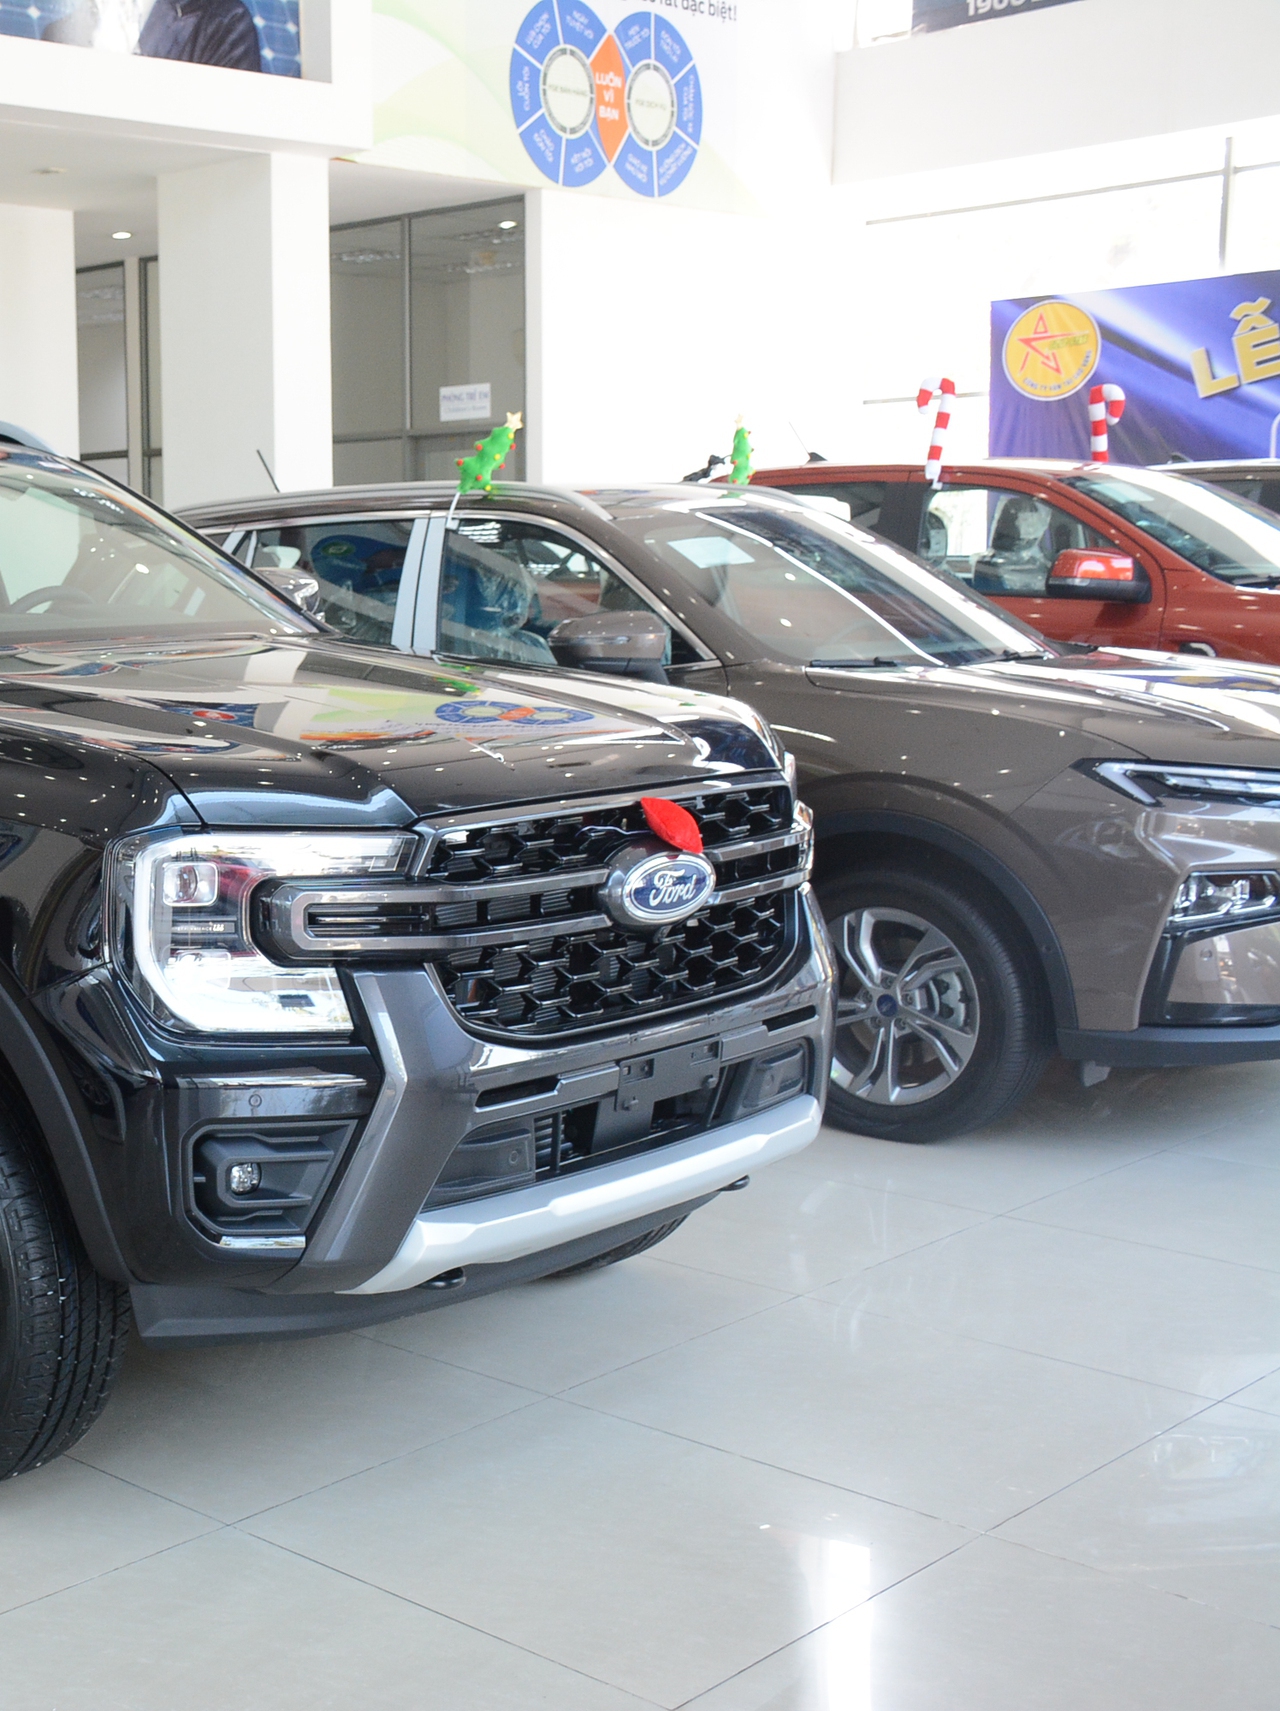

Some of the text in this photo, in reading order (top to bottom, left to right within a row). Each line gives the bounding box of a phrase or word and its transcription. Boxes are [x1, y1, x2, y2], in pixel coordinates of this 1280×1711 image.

[595, 71, 622, 88] LUÔN
[599, 107, 619, 122] BẠN
[1190, 296, 1280, 398] LỄ
[649, 869, 697, 907] Ford
